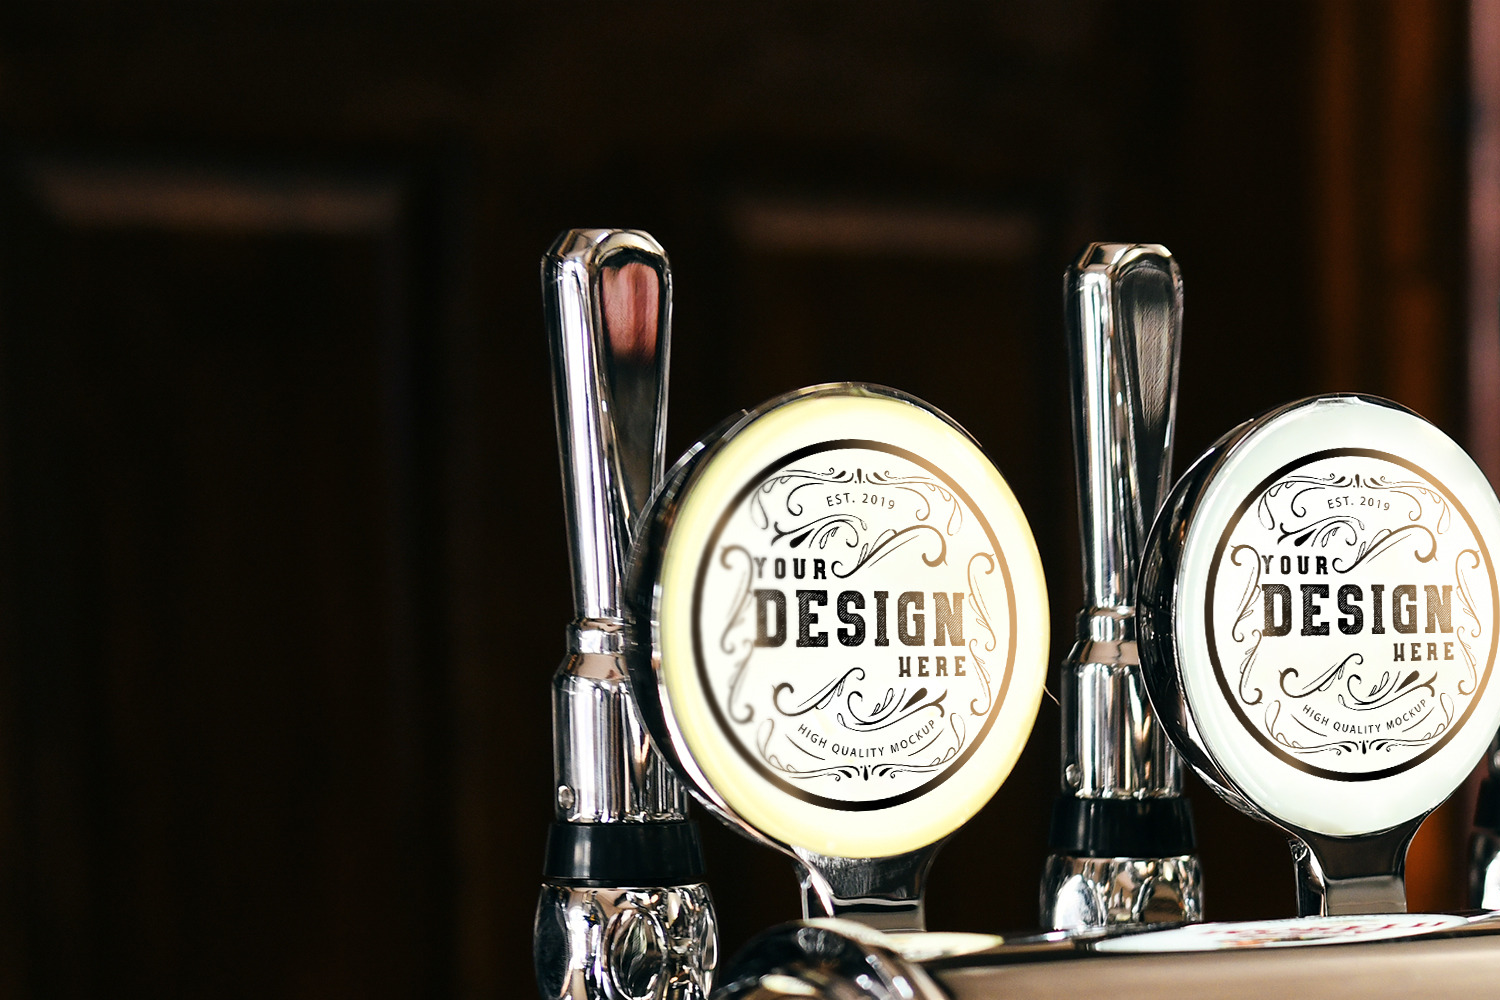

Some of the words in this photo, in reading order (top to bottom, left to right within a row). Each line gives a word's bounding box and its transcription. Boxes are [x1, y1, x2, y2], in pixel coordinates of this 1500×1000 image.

[826, 493, 855, 507] EST.
[862, 493, 895, 509] 2019
[1328, 496, 1354, 509] EST.
[1360, 497, 1390, 511] 2019
[754, 558, 827, 579] YOUR
[1262, 555, 1328, 575] YOUR
[753, 589, 966, 648] DESIGN
[1261, 584, 1454, 636] DESIGN
[1394, 642, 1454, 661] HERE
[899, 656, 966, 677] HERE
[1303, 704, 1329, 726] HIGH
[1333, 721, 1381, 734] QUALITY
[1386, 700, 1426, 730] MOCKUP
[798, 723, 827, 748] HIGH
[832, 744, 885, 757] QUALITY
[891, 720, 935, 753] MOCKUP
